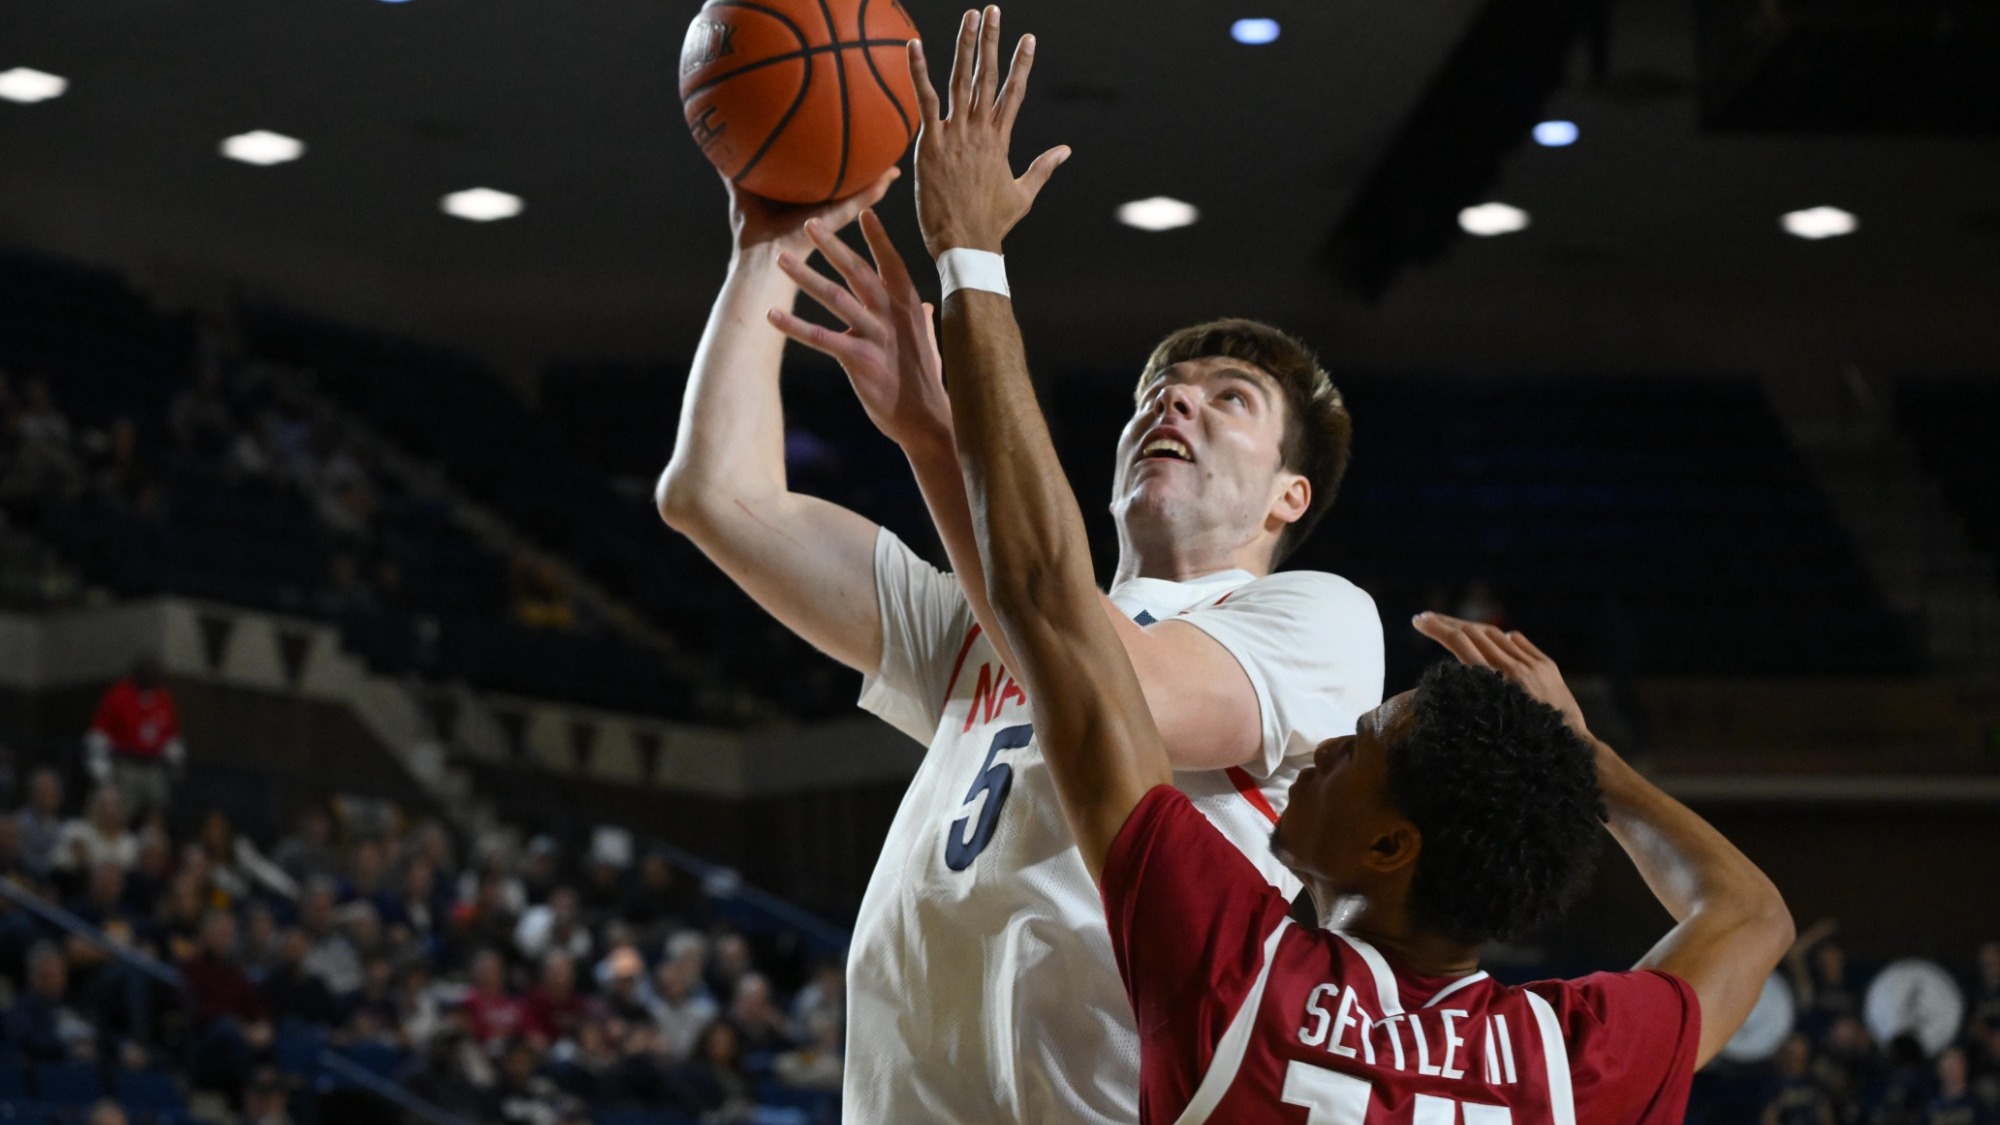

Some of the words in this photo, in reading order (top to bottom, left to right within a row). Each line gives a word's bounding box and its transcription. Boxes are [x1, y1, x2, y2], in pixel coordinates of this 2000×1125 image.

[945, 723, 1034, 872] 5
[1298, 982, 1469, 1080] SETTLE
[1485, 1014, 1518, 1085] II
